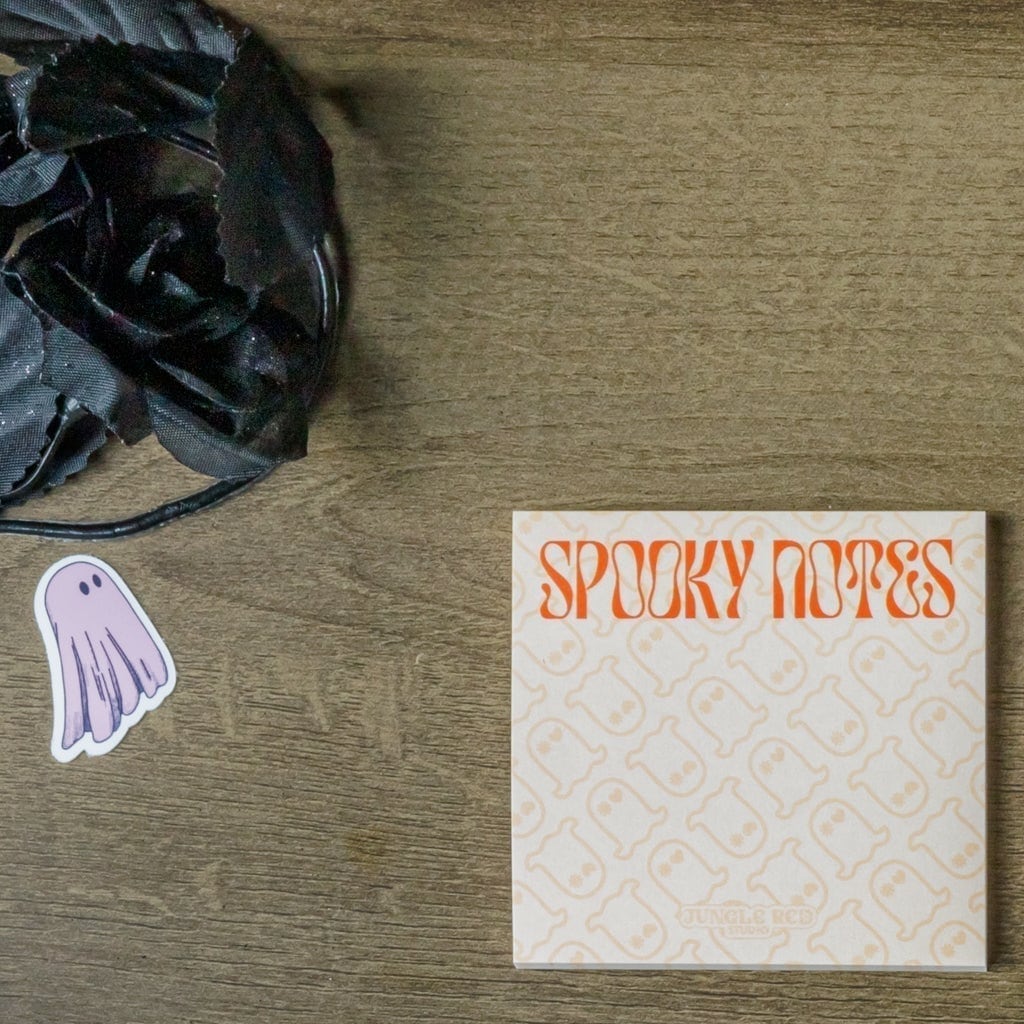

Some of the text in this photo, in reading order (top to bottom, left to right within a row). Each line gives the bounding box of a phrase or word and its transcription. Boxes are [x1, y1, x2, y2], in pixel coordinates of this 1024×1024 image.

[540, 539, 956, 619] SPOOKY NOTES
[683, 908, 813, 925] JUNGLE RED
